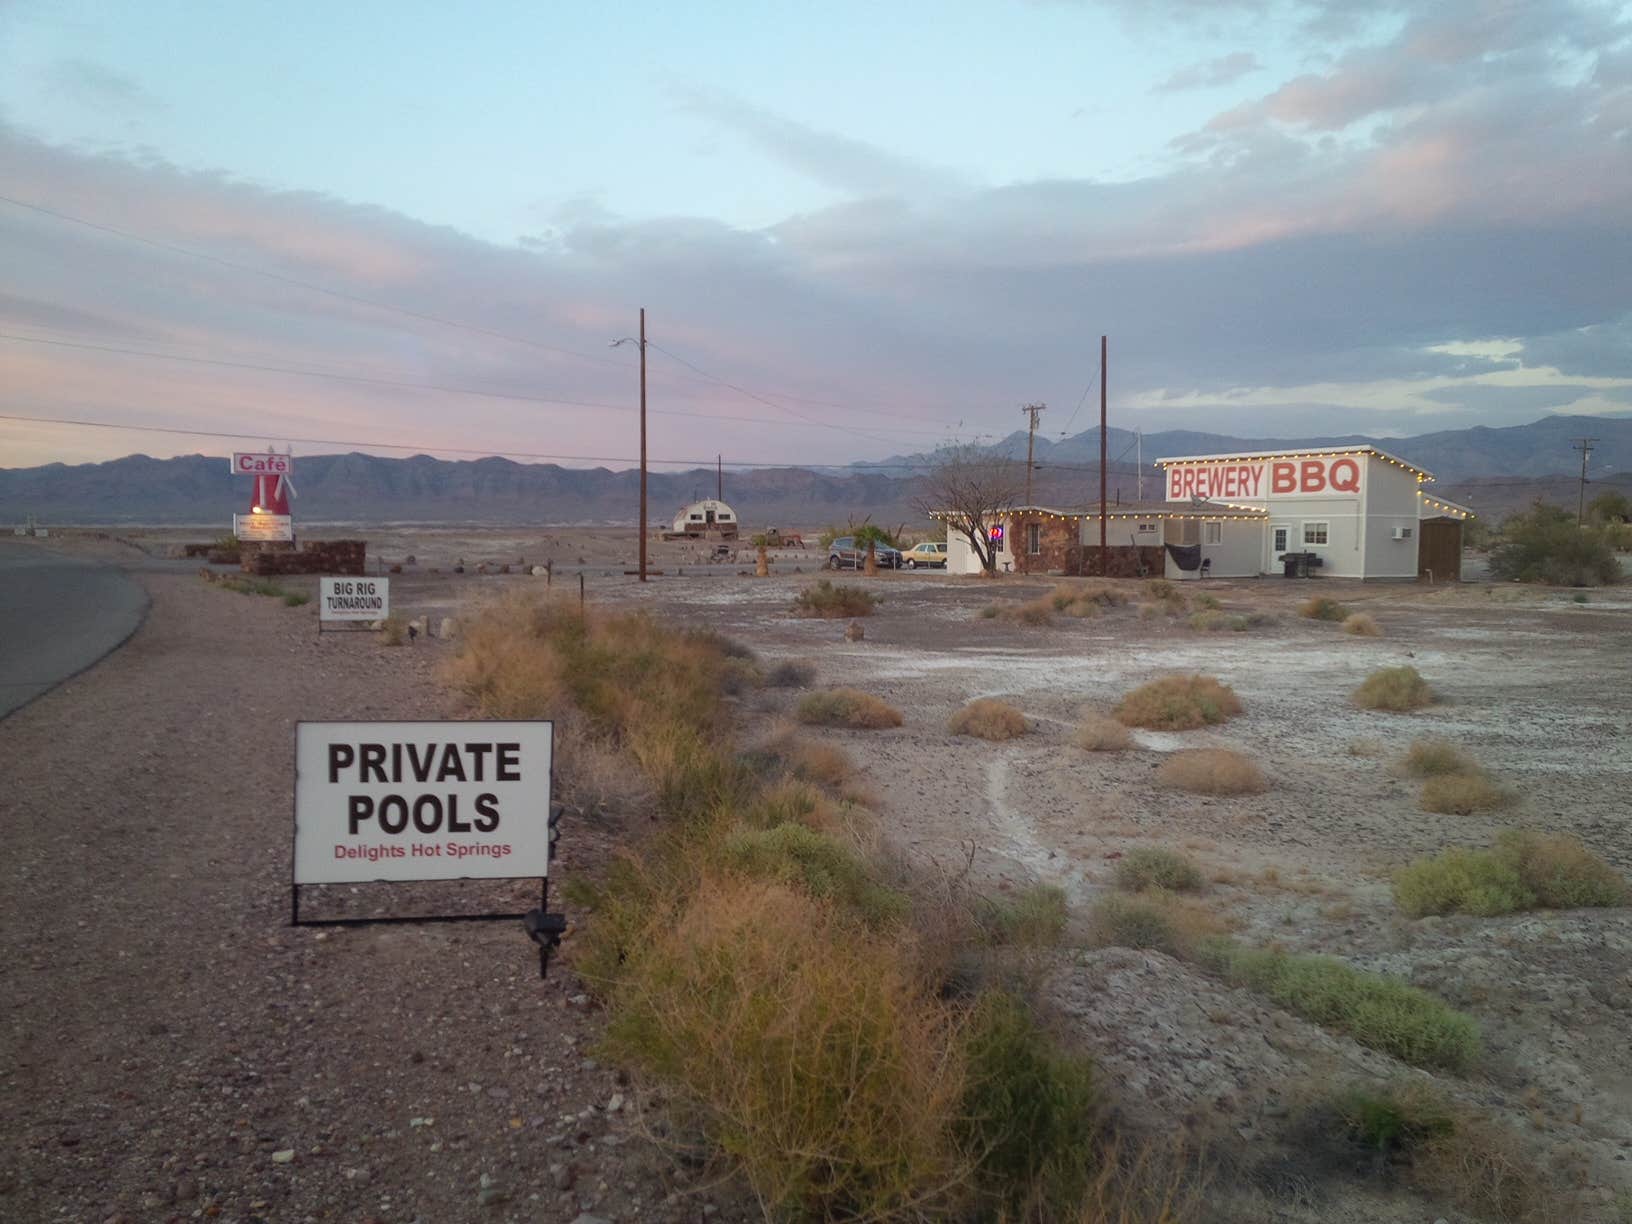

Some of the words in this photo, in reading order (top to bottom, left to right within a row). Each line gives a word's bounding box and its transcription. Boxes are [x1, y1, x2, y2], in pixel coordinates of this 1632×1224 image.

[239, 456, 286, 471] Café
[1170, 465, 1264, 499] BREWERY
[1271, 458, 1361, 494] BBQ
[334, 582, 353, 595] BIG
[356, 582, 376, 595] RIG
[327, 596, 383, 609] TURNAROUND
[328, 742, 521, 783] PRIVATE
[348, 792, 501, 835] POOLS
[334, 843, 406, 861] Delights
[411, 843, 442, 857] Hot
[446, 842, 512, 859] Springs
